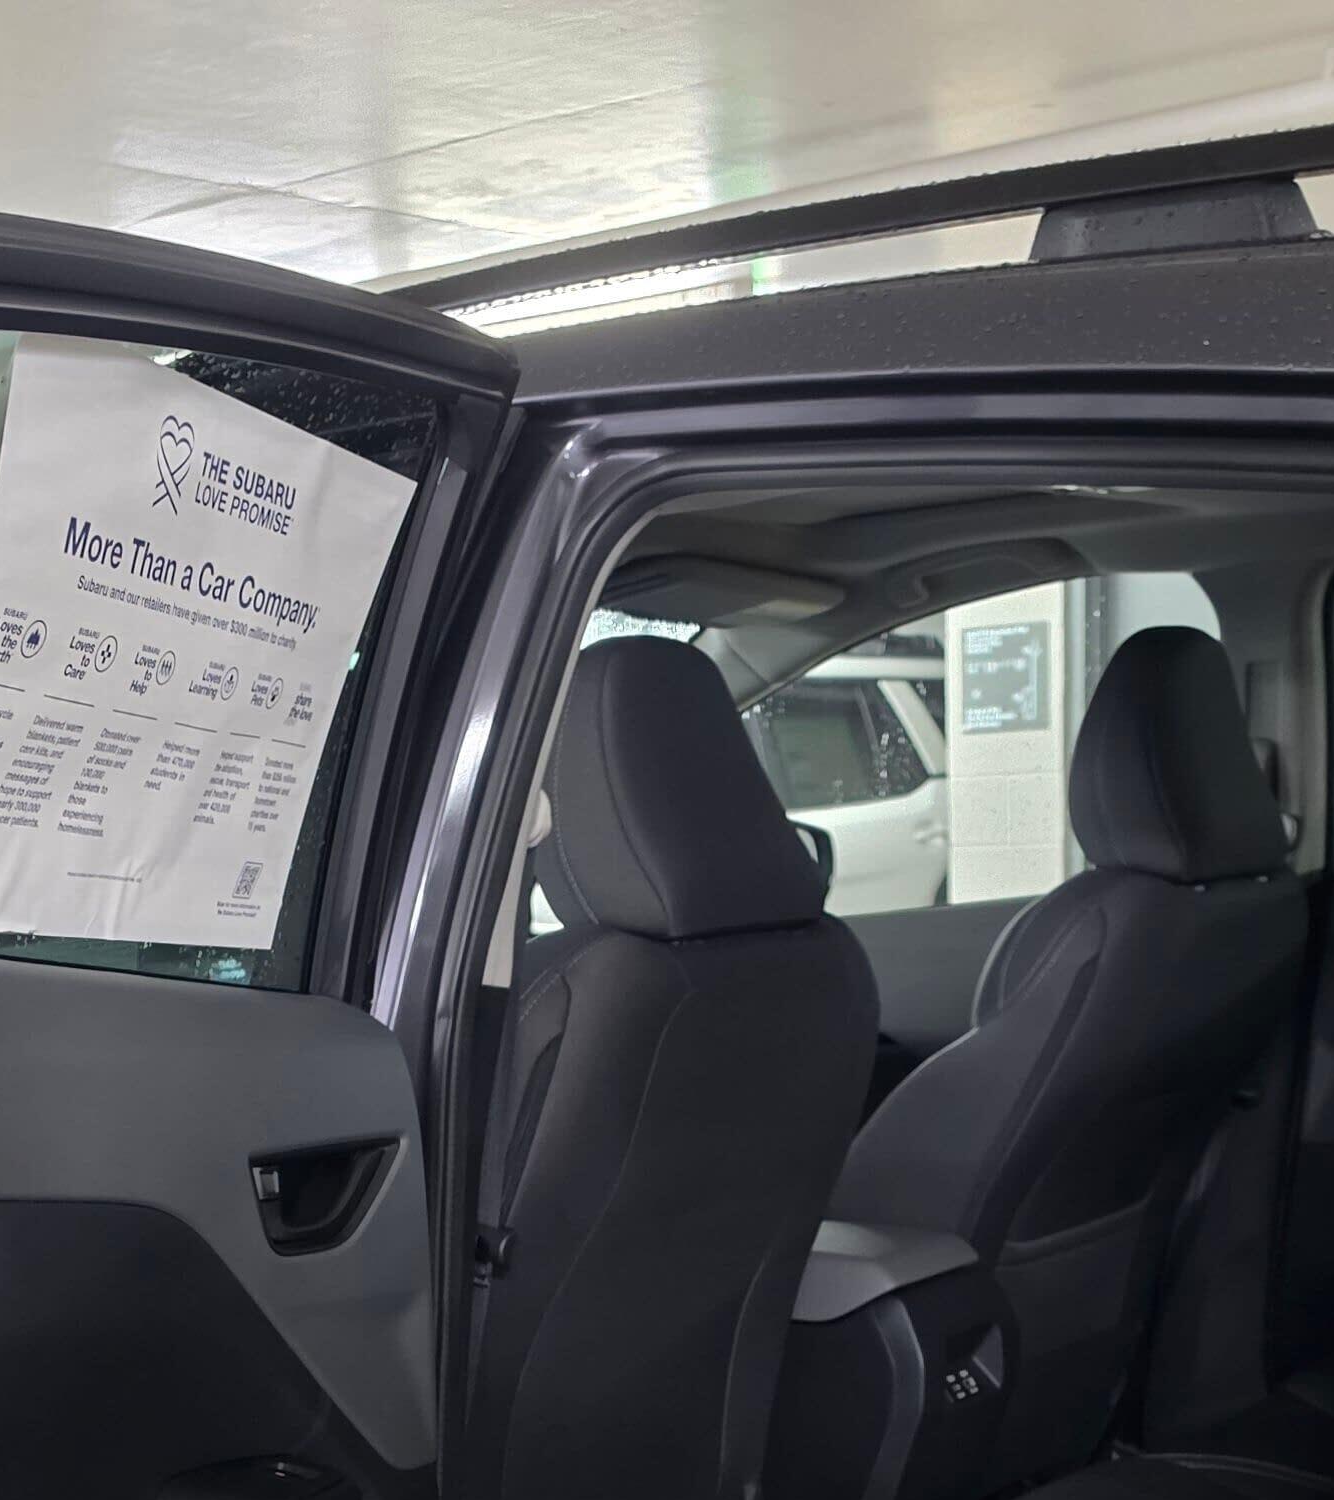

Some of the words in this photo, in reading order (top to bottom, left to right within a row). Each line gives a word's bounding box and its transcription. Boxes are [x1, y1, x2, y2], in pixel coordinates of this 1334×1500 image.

[202, 452, 230, 484] THE
[233, 466, 296, 510] SUBARU
[195, 481, 228, 512] LOVE
[230, 496, 292, 536] PROMISE
[64, 516, 123, 569] More
[130, 538, 177, 586] Than
[181, 565, 193, 591] a
[198, 562, 235, 602] Car
[3, 607, 28, 621] SUBARU
[77, 575, 109, 597] Subaru
[109, 587, 125, 601] and
[126, 593, 141, 605] our
[140, 595, 171, 615] retailers
[172, 603, 190, 620] have
[191, 610, 211, 625] given
[212, 617, 229, 630] over
[248, 626, 270, 642] million
[270, 632, 277, 644] to
[78, 627, 101, 640] SUBARU
[1, 635, 17, 650] the
[69, 636, 96, 654] Loves
[81, 655, 91, 668] to
[135, 652, 157, 669] Loves
[64, 664, 86, 681] Care
[144, 669, 152, 681] to
[202, 668, 222, 684] Loves
[130, 680, 147, 696] Help
[189, 680, 218, 701] Learning
[251, 681, 268, 694] Loves
[294, 693, 313, 707] share
[33, 715, 66, 730] Delivered
[66, 723, 84, 733] warm
[100, 728, 127, 741] Donated
[19, 745, 35, 754] care
[49, 750, 64, 759] and
[12, 759, 55, 774] encouraging
[150, 767, 178, 780] students
[5, 772, 40, 785] messages
[39, 777, 50, 785] of
[17, 787, 25, 796] to
[25, 789, 52, 800] support
[73, 780, 100, 793] blankets
[68, 794, 86, 805] those
[62, 809, 103, 825] experiencing
